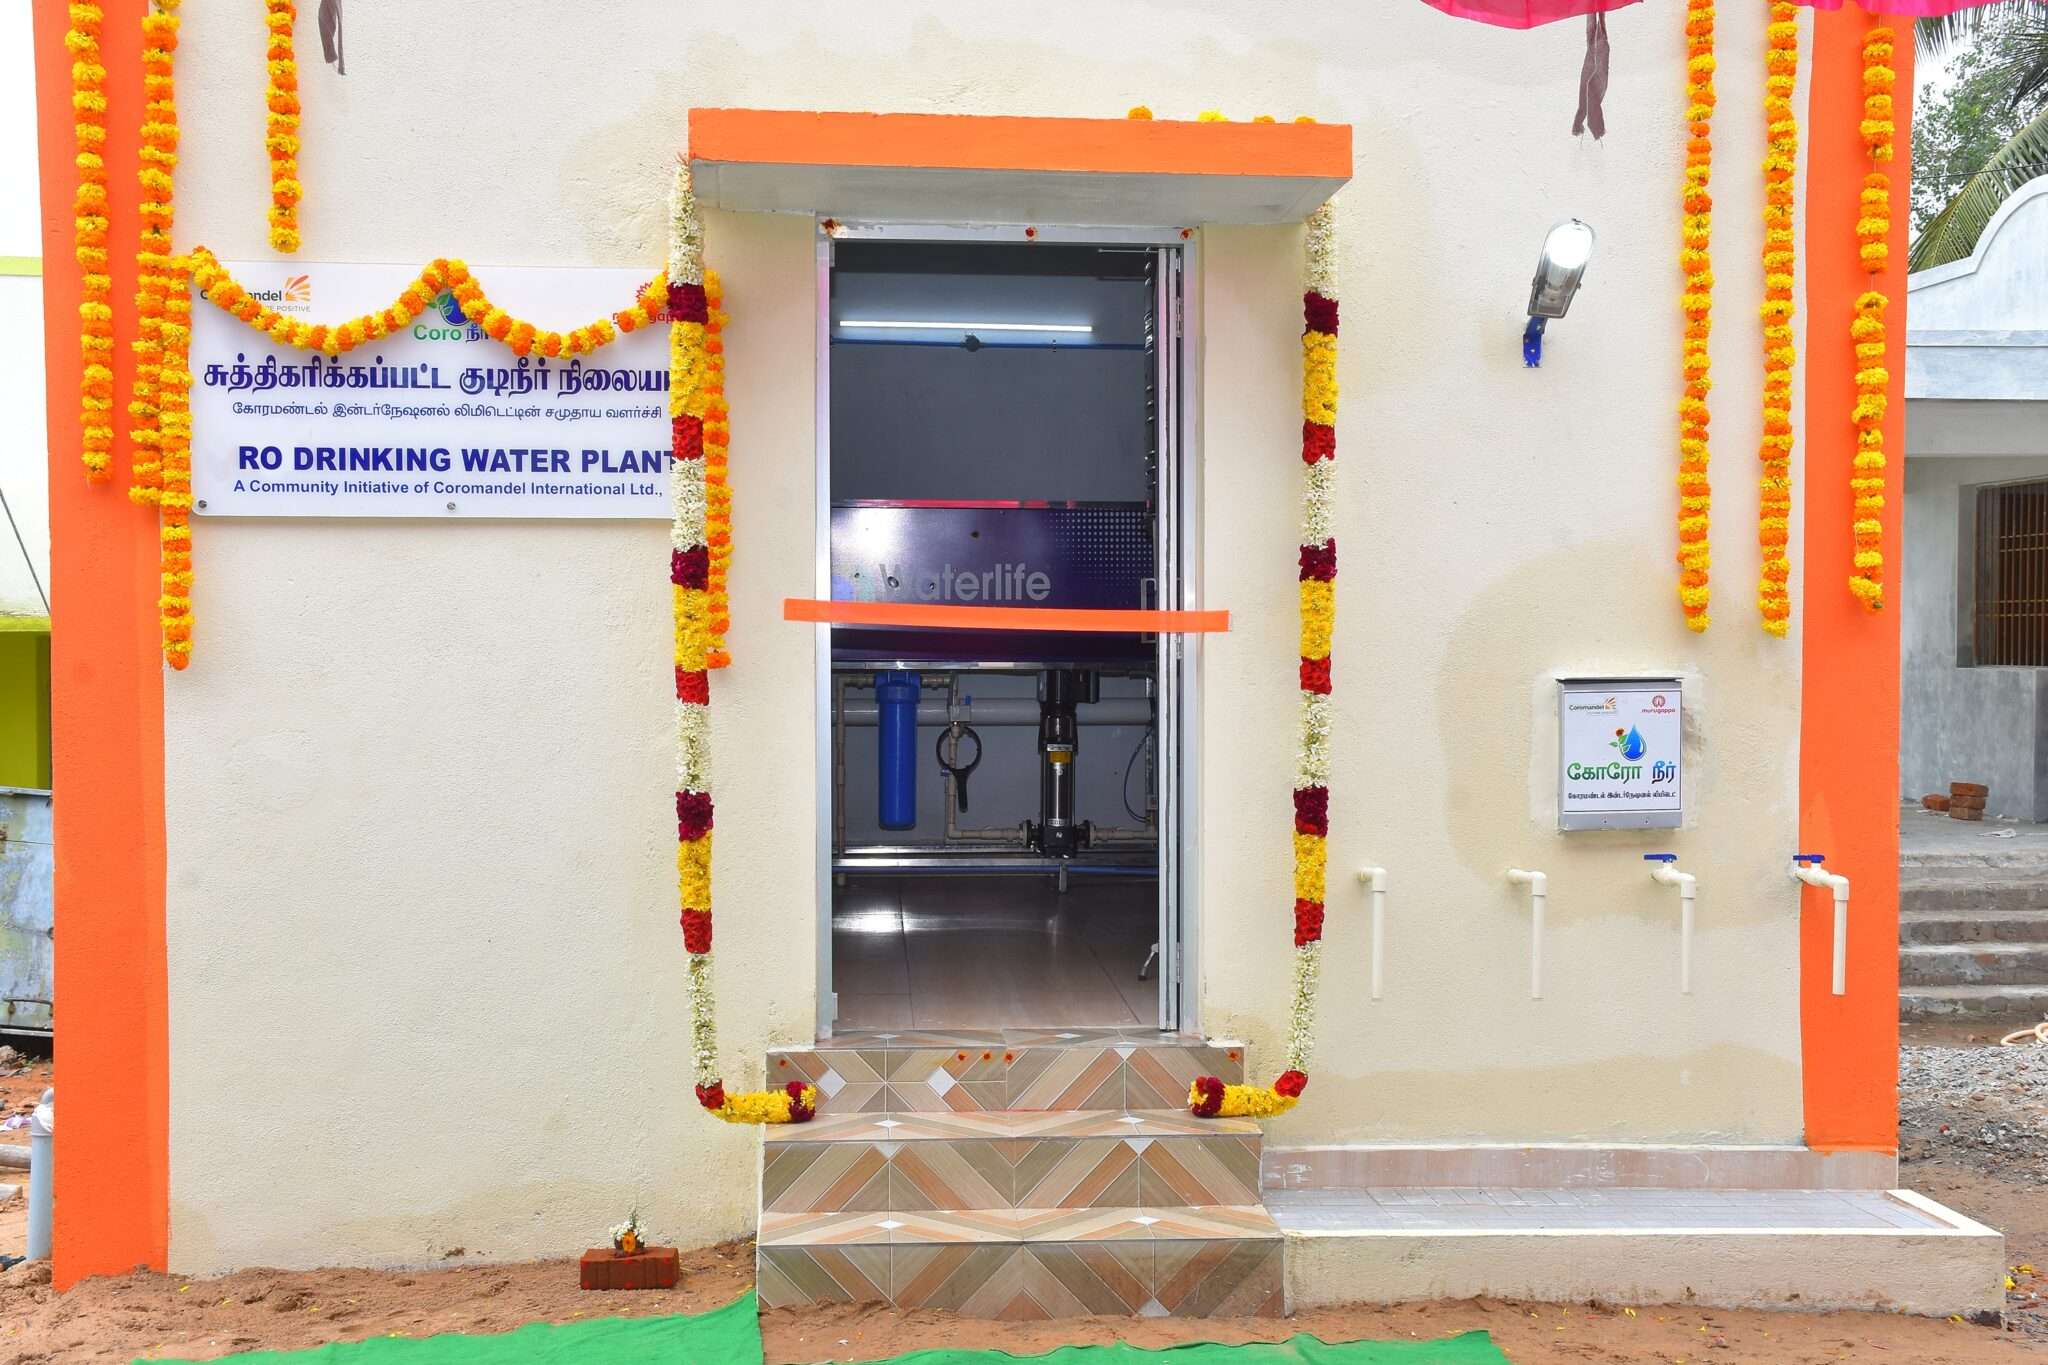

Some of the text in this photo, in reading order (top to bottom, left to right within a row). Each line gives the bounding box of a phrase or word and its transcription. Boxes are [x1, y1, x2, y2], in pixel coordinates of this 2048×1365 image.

[200, 288, 282, 301] Cndel
[414, 324, 462, 341] Coro
[203, 352, 452, 395] சுத்திகரிக்கப்பட்ட
[459, 356, 551, 398] குடிநீர்
[232, 401, 662, 421] கோரமண்டல் இன்டர்நேஷனல் லிமிடெட்டின் சமுதாய வளர்ச்சி
[239, 446, 283, 470] RO
[294, 447, 451, 472] DRINKING
[461, 448, 571, 473] WATER
[233, 480, 663, 497] A Community Initiative of Coromandel International Ltd.,
[1567, 760, 1676, 784] கோரோ நீர்
